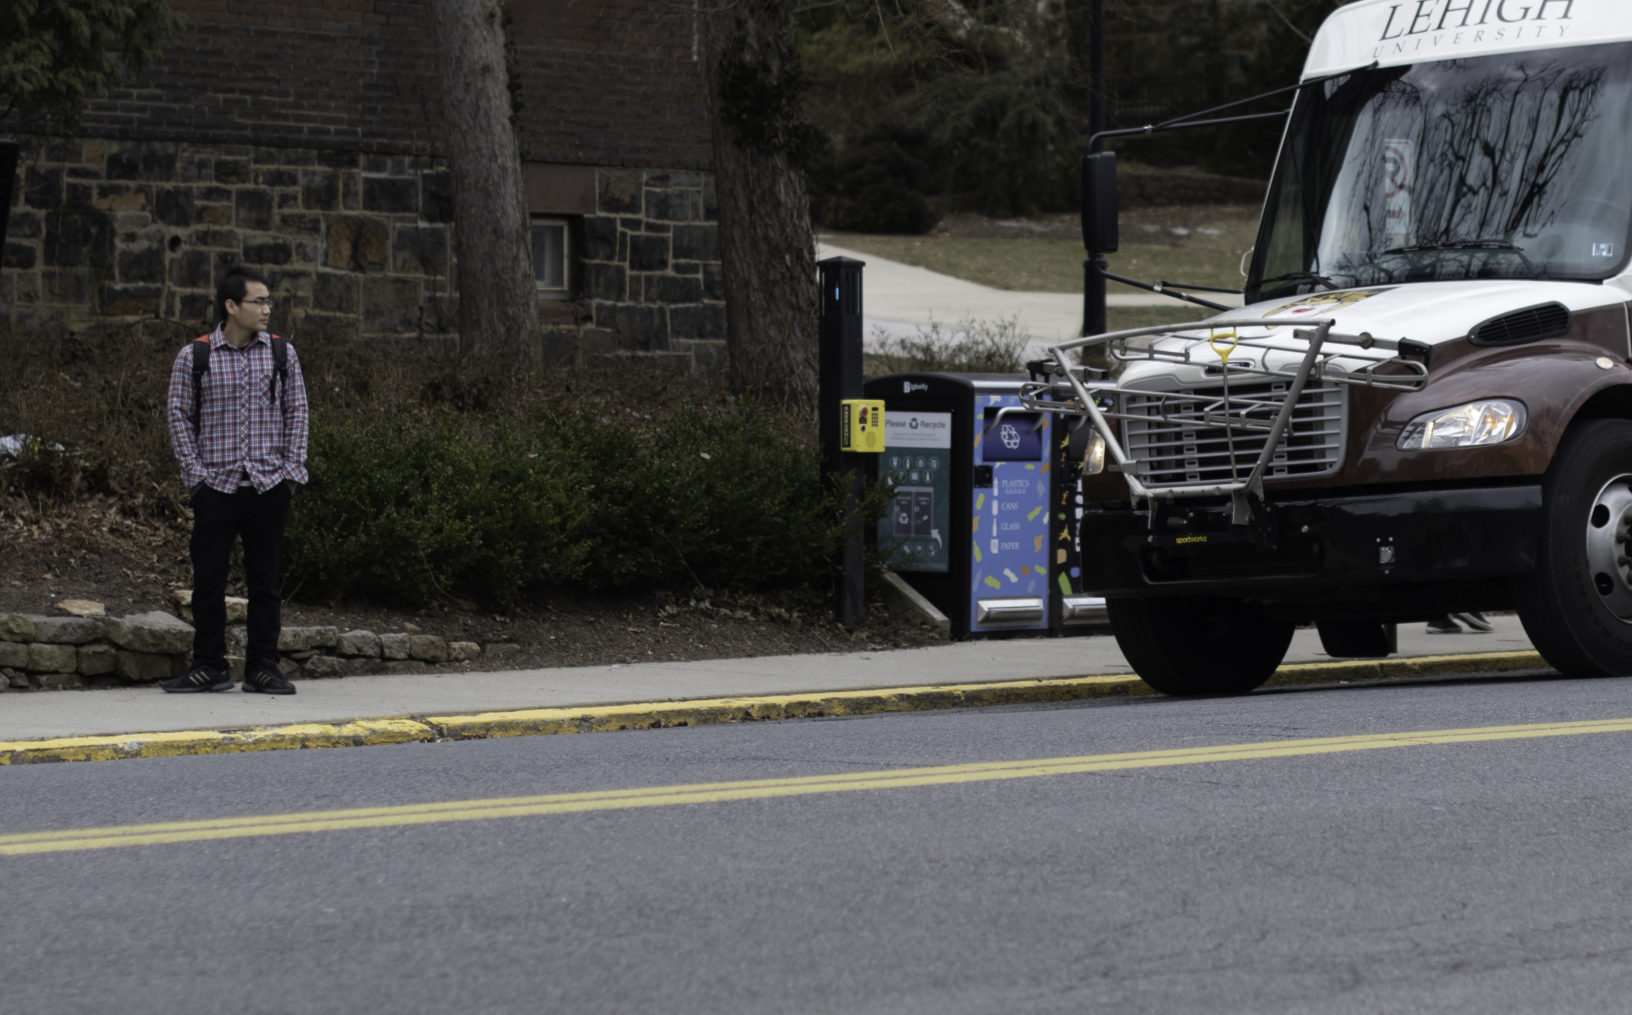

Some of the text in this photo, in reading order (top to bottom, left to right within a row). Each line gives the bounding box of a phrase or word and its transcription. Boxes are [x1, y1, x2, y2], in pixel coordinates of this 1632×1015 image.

[1372, 24, 1570, 59] UNIVERSITY
[885, 418, 947, 431] Please Recycle
